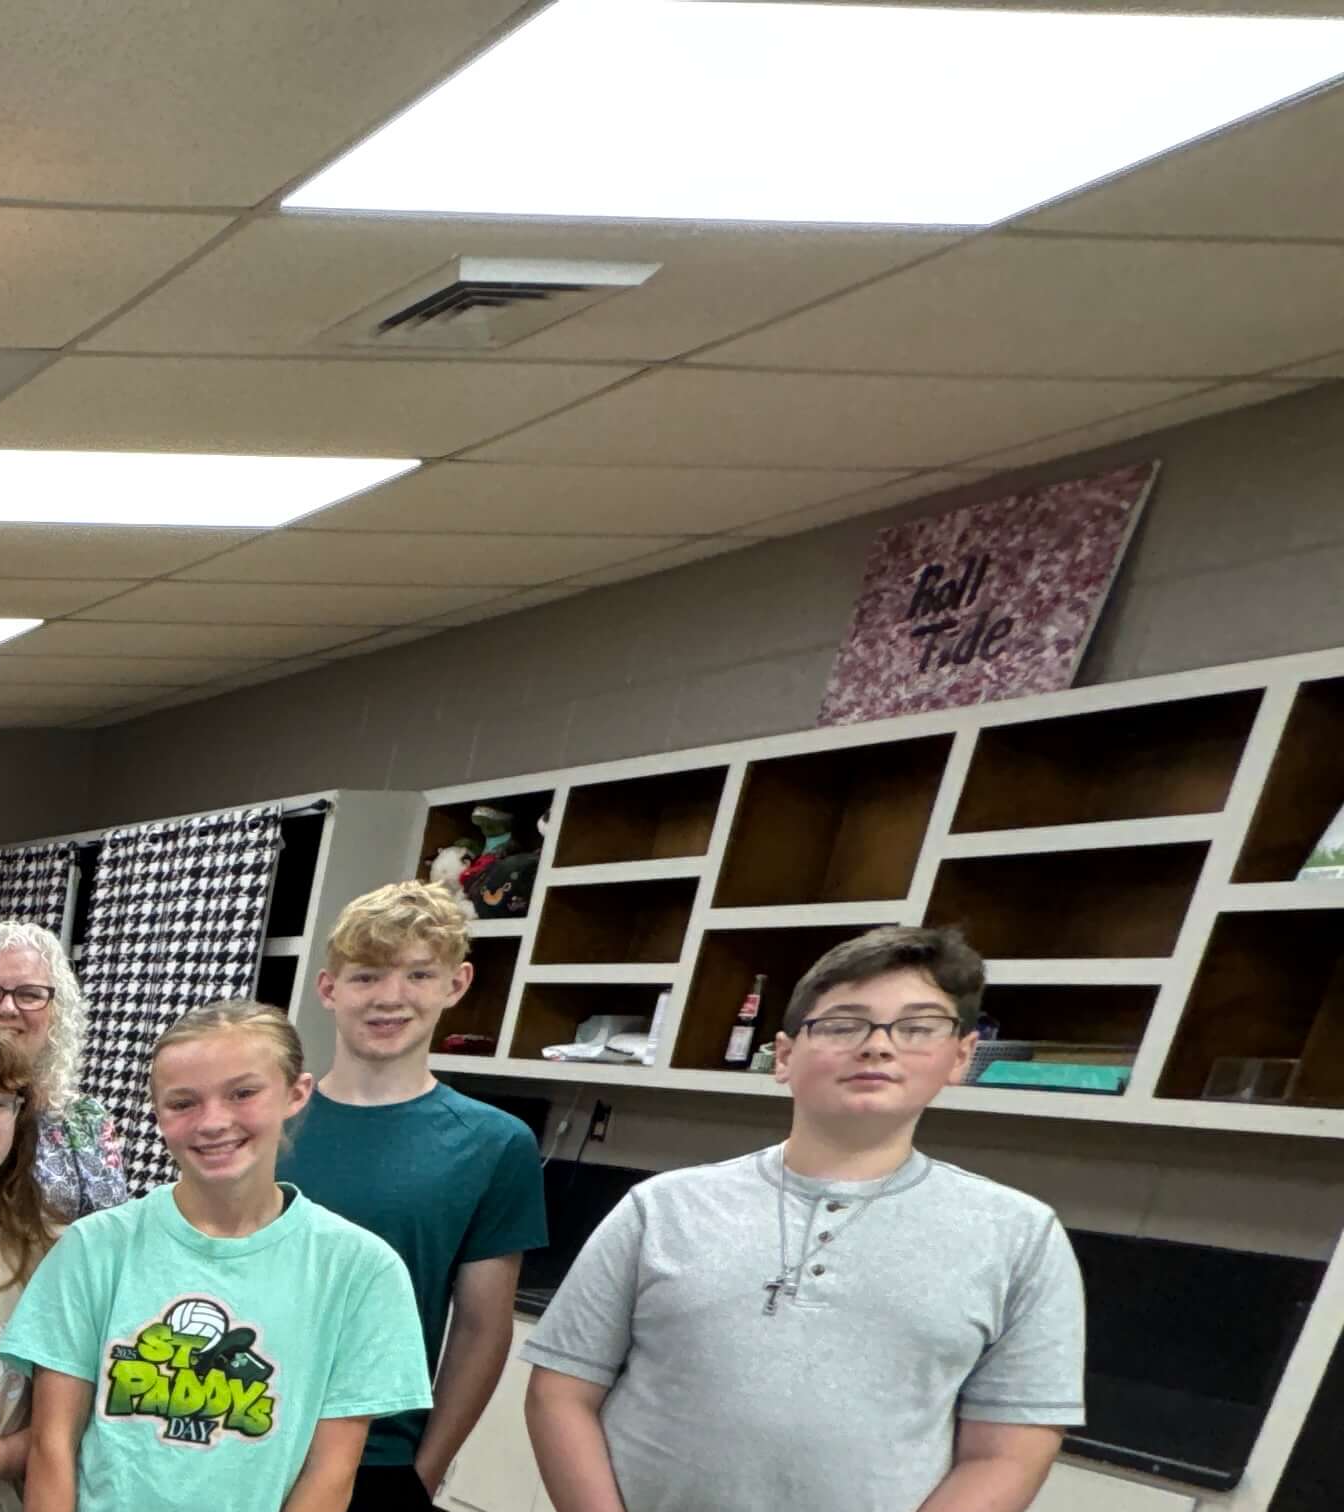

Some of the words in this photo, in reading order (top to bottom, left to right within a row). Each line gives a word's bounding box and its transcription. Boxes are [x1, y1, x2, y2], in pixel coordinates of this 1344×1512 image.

[906, 554, 991, 619] Roll
[911, 615, 1015, 673] Tide
[169, 1418, 215, 1441] DAY
